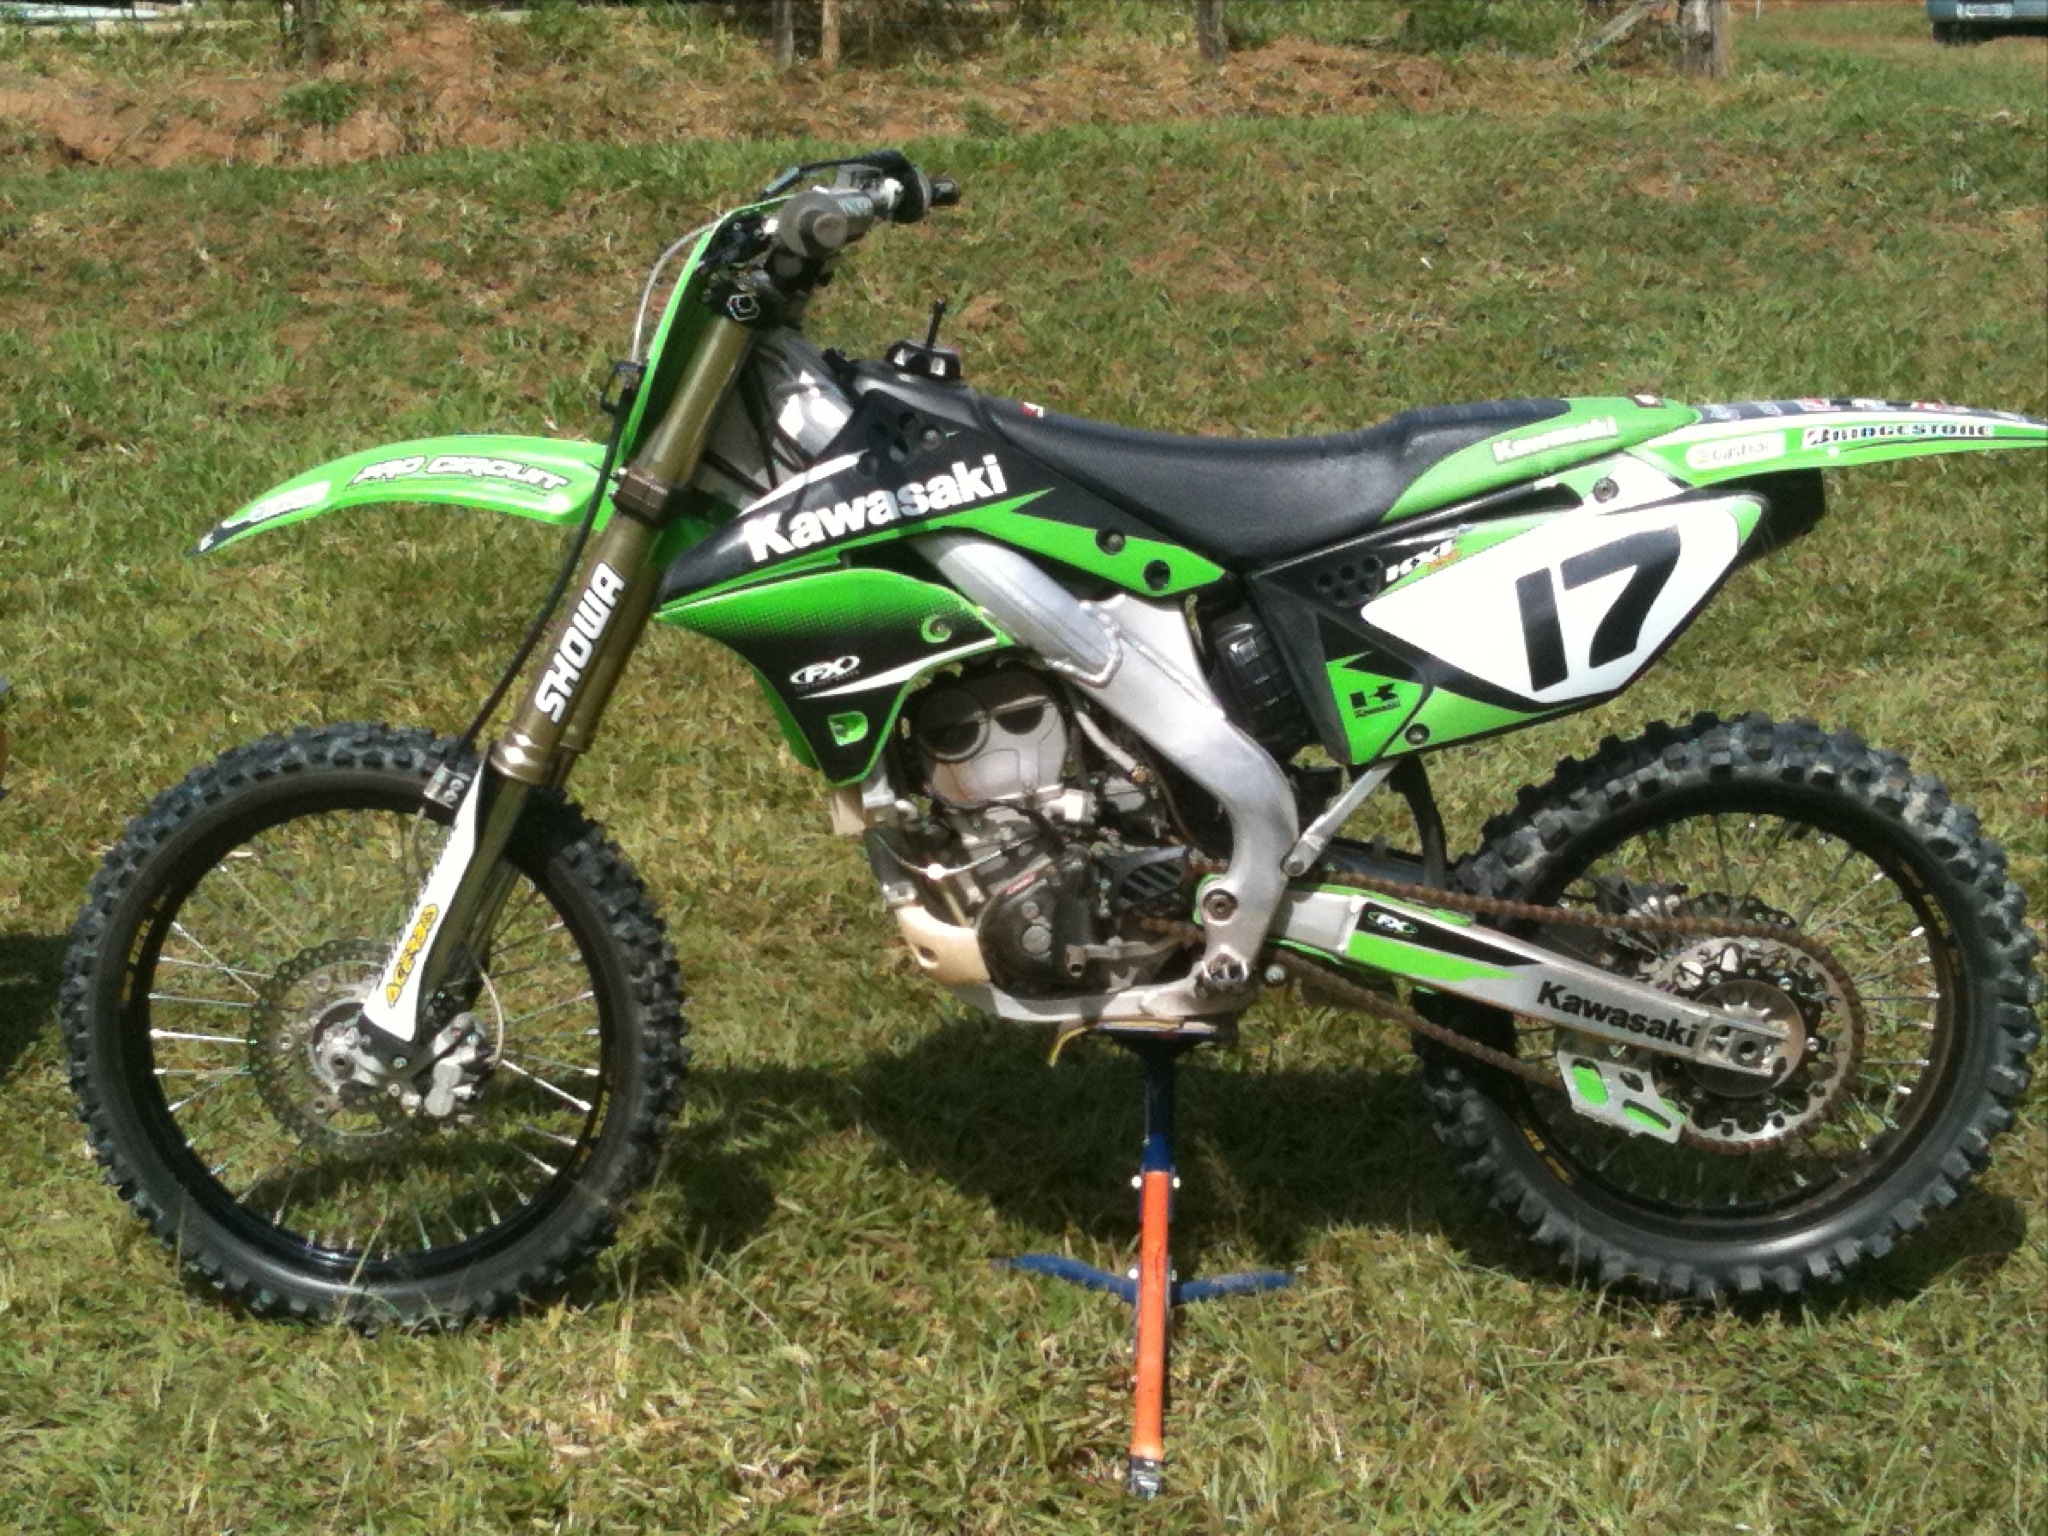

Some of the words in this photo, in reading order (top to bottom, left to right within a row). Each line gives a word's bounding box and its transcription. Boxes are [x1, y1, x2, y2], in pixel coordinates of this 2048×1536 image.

[742, 453, 1008, 563] Kawasaki
[534, 561, 627, 724] SHOWA
[1515, 524, 1682, 692] 17
[1536, 980, 1701, 1048] Kawasaki
